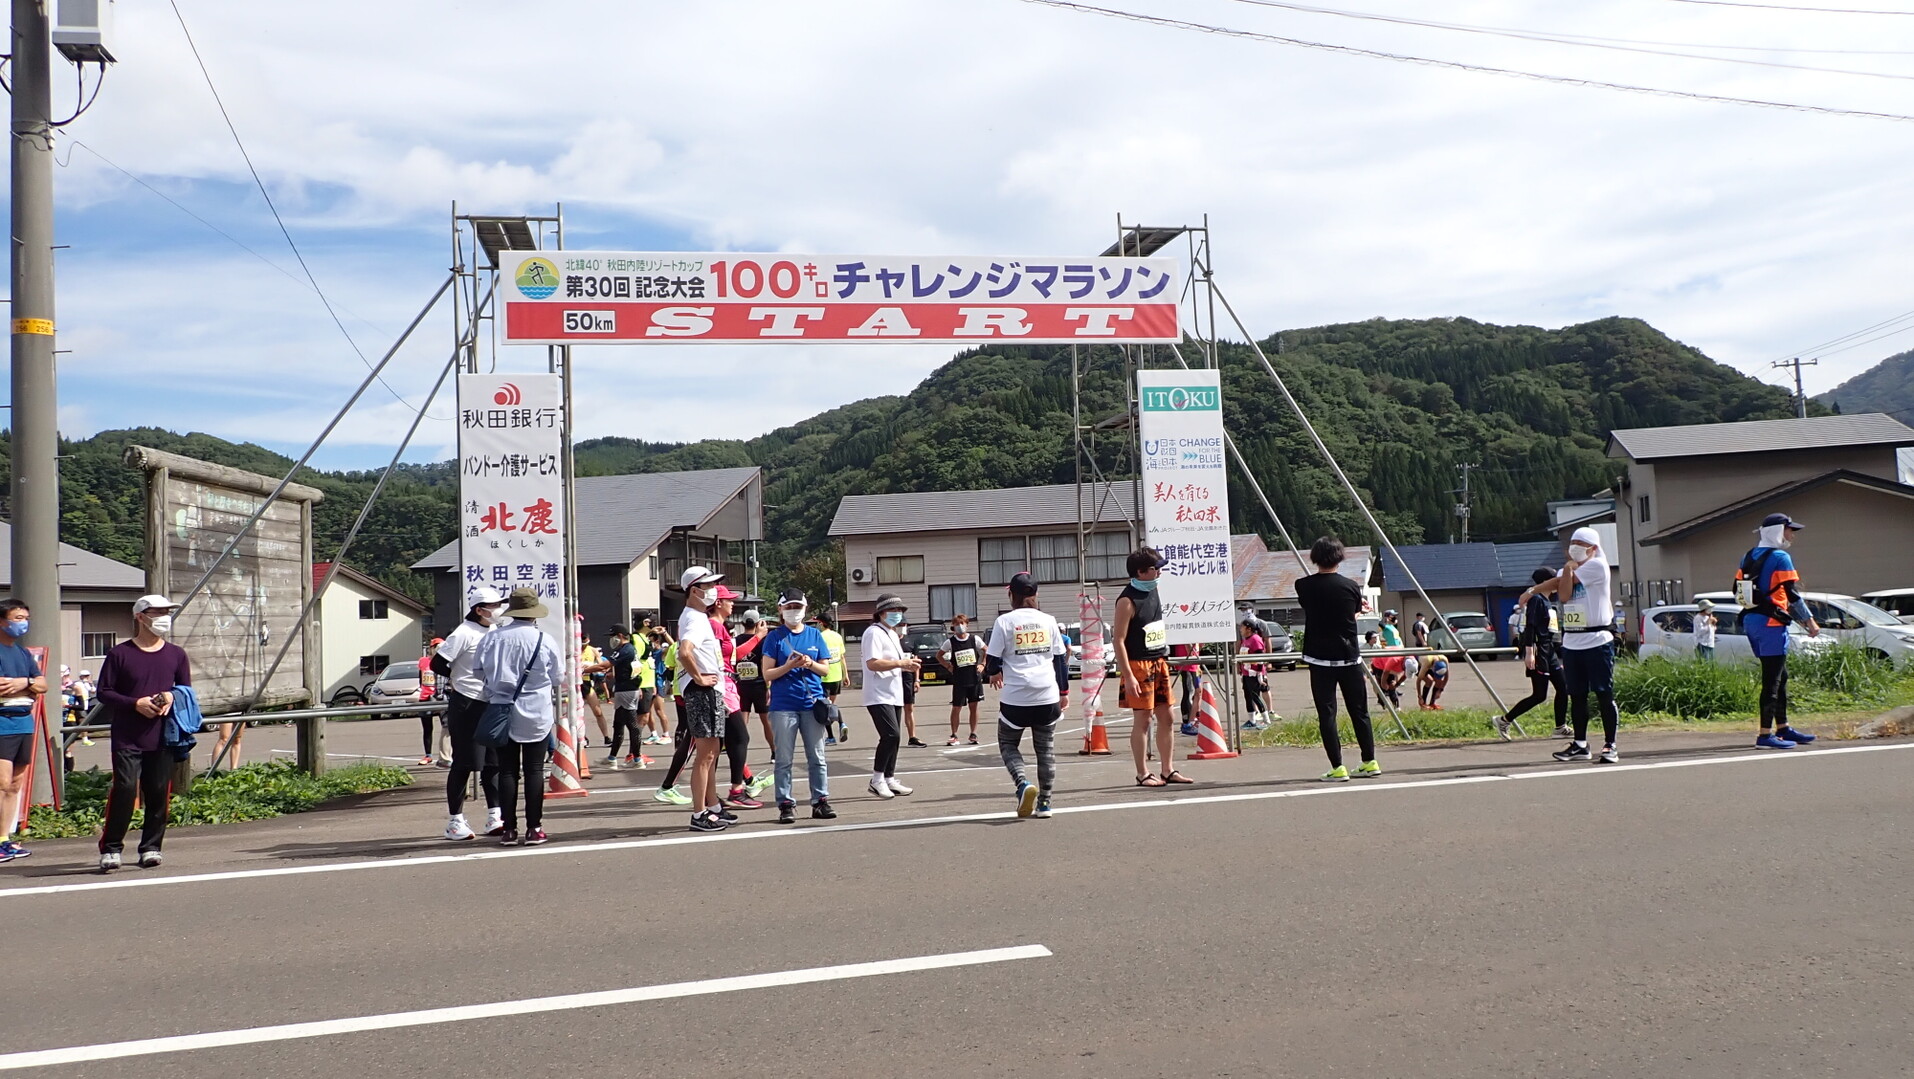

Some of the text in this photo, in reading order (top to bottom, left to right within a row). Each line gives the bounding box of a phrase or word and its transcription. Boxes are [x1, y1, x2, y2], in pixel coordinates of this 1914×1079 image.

[565, 275, 706, 299] 第30回 記念大会
[565, 312, 614, 333] 50km
[644, 306, 1136, 338] START
[1146, 387, 1216, 411] ITOKU
[462, 408, 557, 430] 秋田銀行
[1179, 437, 1221, 447] CHANGE
[463, 453, 558, 478] バンドー介護サービス
[1199, 453, 1222, 464] BLUE
[480, 497, 558, 535] 北鹿
[490, 539, 545, 549] ほくしか
[466, 562, 559, 582] 秋田空港
[1015, 631, 1045, 646] 5123
